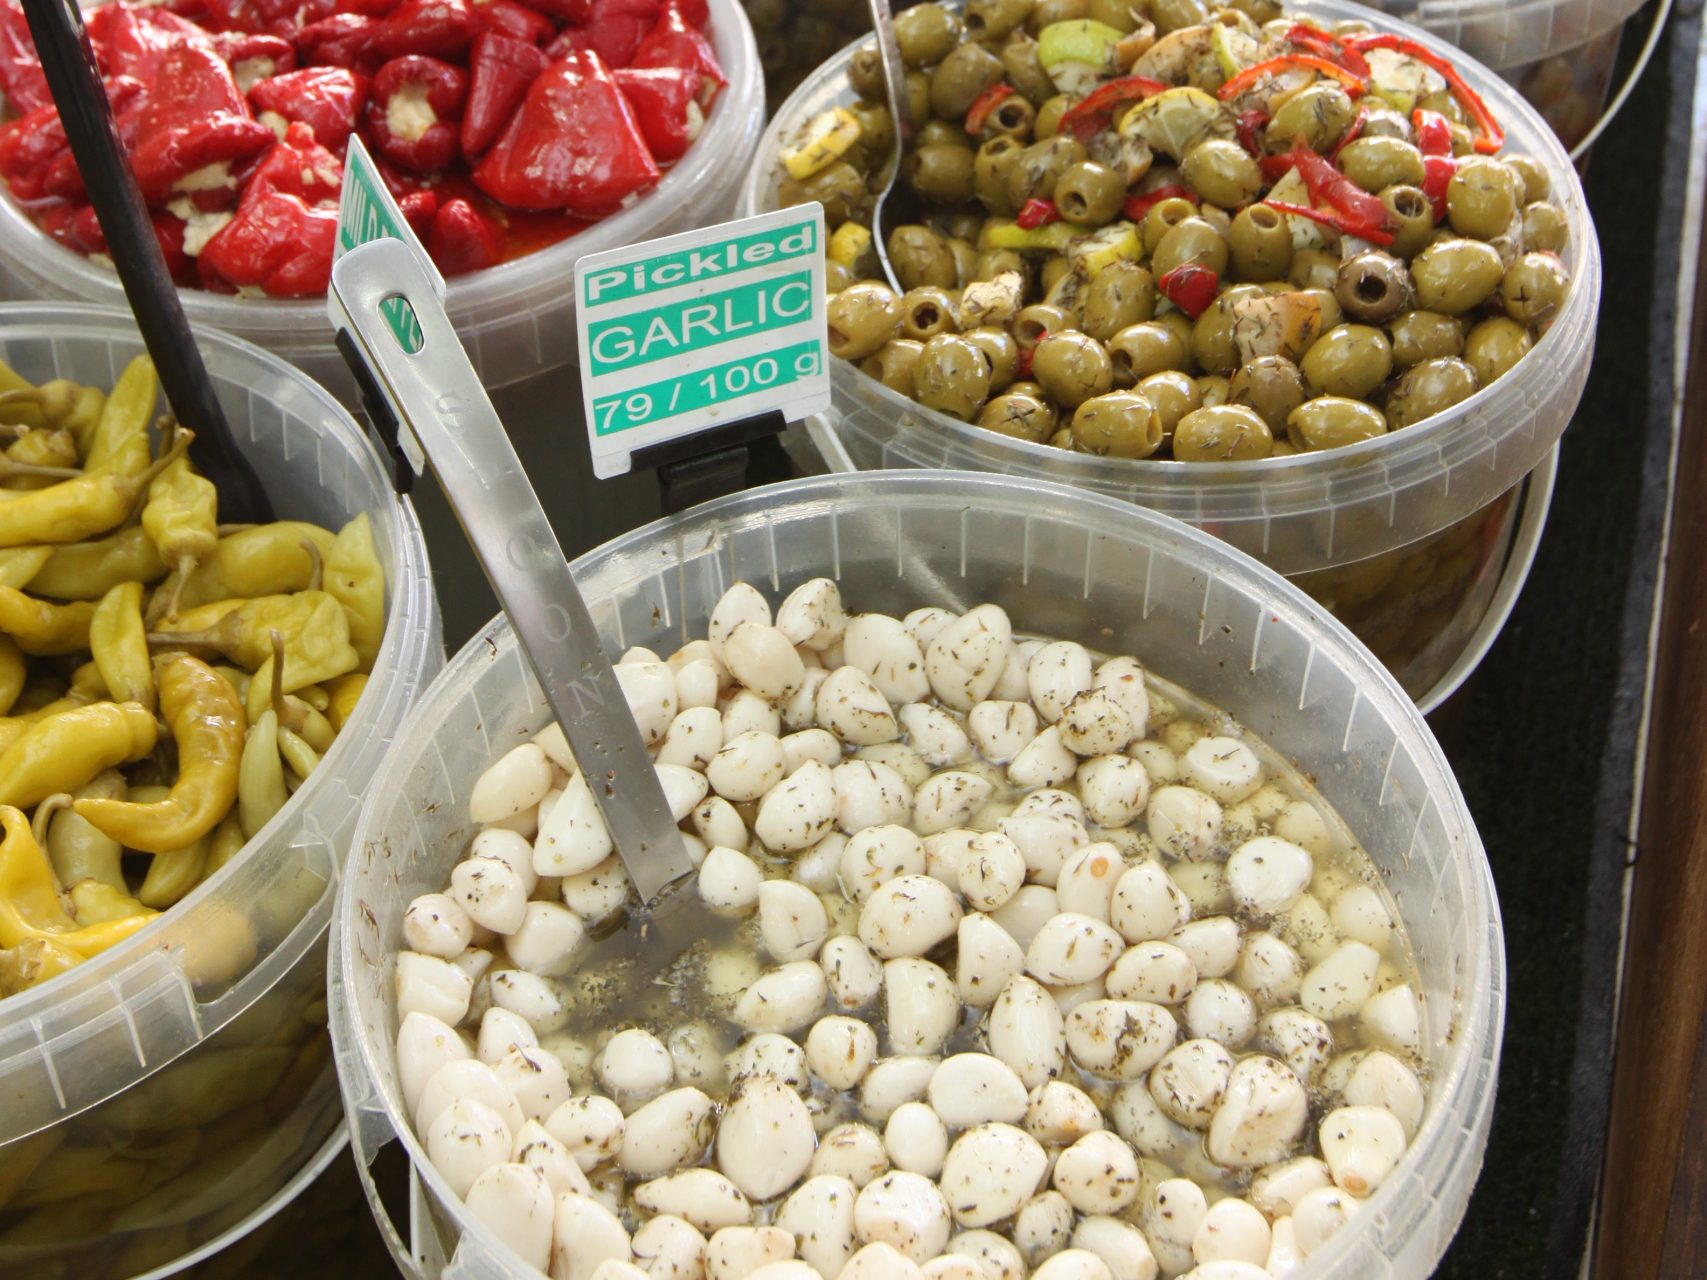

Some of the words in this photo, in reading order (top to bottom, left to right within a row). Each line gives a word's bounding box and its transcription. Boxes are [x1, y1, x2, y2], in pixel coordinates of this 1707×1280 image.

[587, 225, 813, 301] Pickled
[591, 281, 811, 364] GARLIC
[595, 392, 653, 429] 79
[668, 382, 682, 412] /
[699, 358, 779, 400] 100
[793, 350, 820, 381] g
